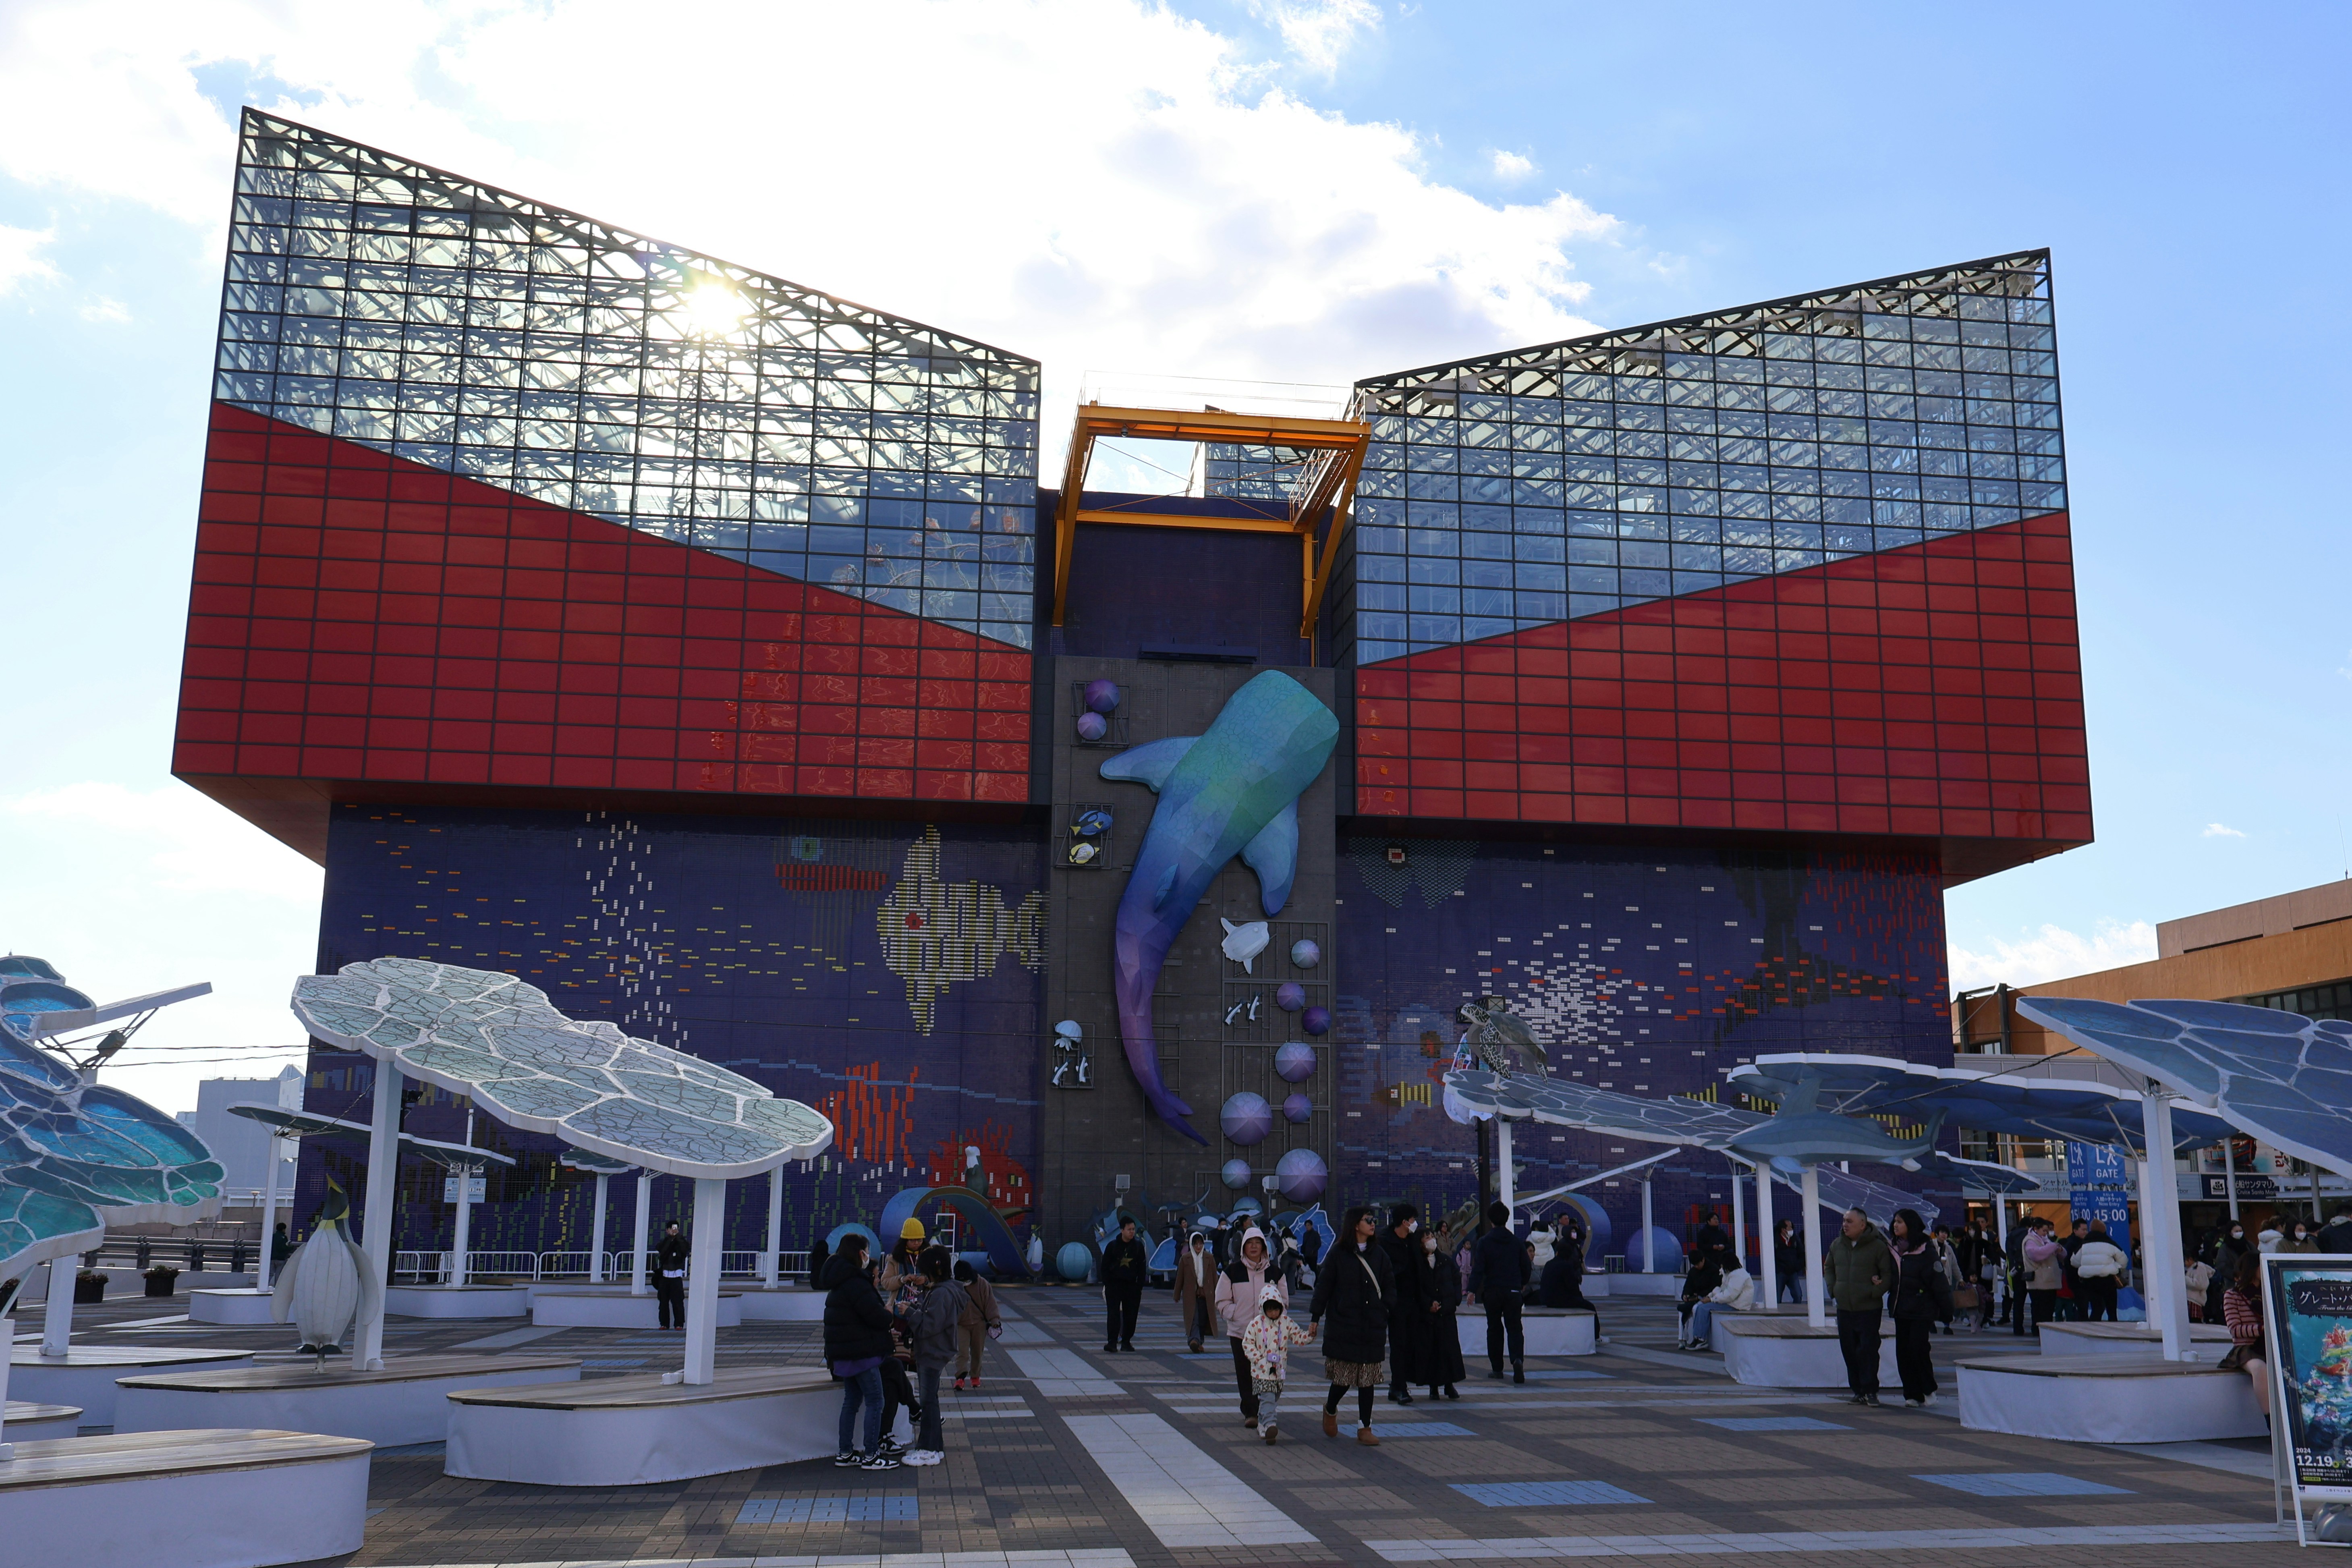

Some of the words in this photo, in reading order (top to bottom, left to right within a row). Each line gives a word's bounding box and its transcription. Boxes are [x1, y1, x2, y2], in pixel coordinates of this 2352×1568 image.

[2072, 1169, 2084, 1178] GATE
[2096, 1169, 2118, 1178] GATE
[2070, 1209, 2090, 1221] 15:00
[2095, 1209, 2126, 1221] 15:00
[2296, 1455, 2333, 1467] 12.19
